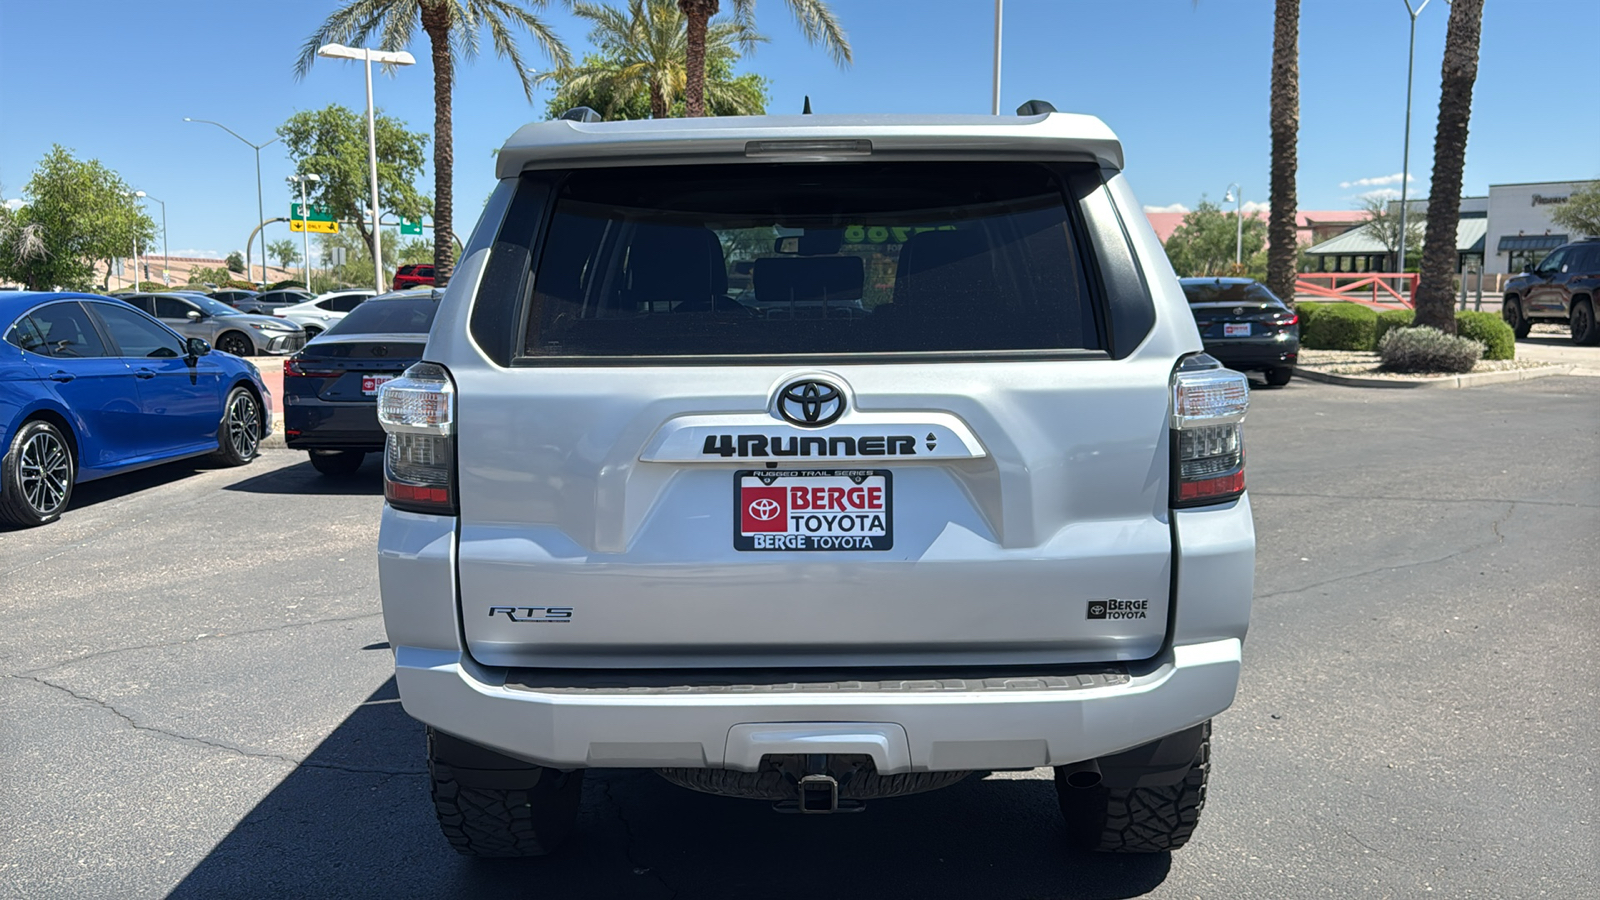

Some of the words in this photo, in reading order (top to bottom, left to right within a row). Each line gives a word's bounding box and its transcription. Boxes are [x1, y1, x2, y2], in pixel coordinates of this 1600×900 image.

[790, 486, 883, 512] BERGE
[790, 515, 885, 532] TOYOTA
[754, 535, 806, 550] BERGE
[812, 536, 873, 548] TOYOTA
[1108, 599, 1148, 611] BERGE
[488, 606, 574, 622] RTS
[1107, 611, 1147, 620] TOYOTA
